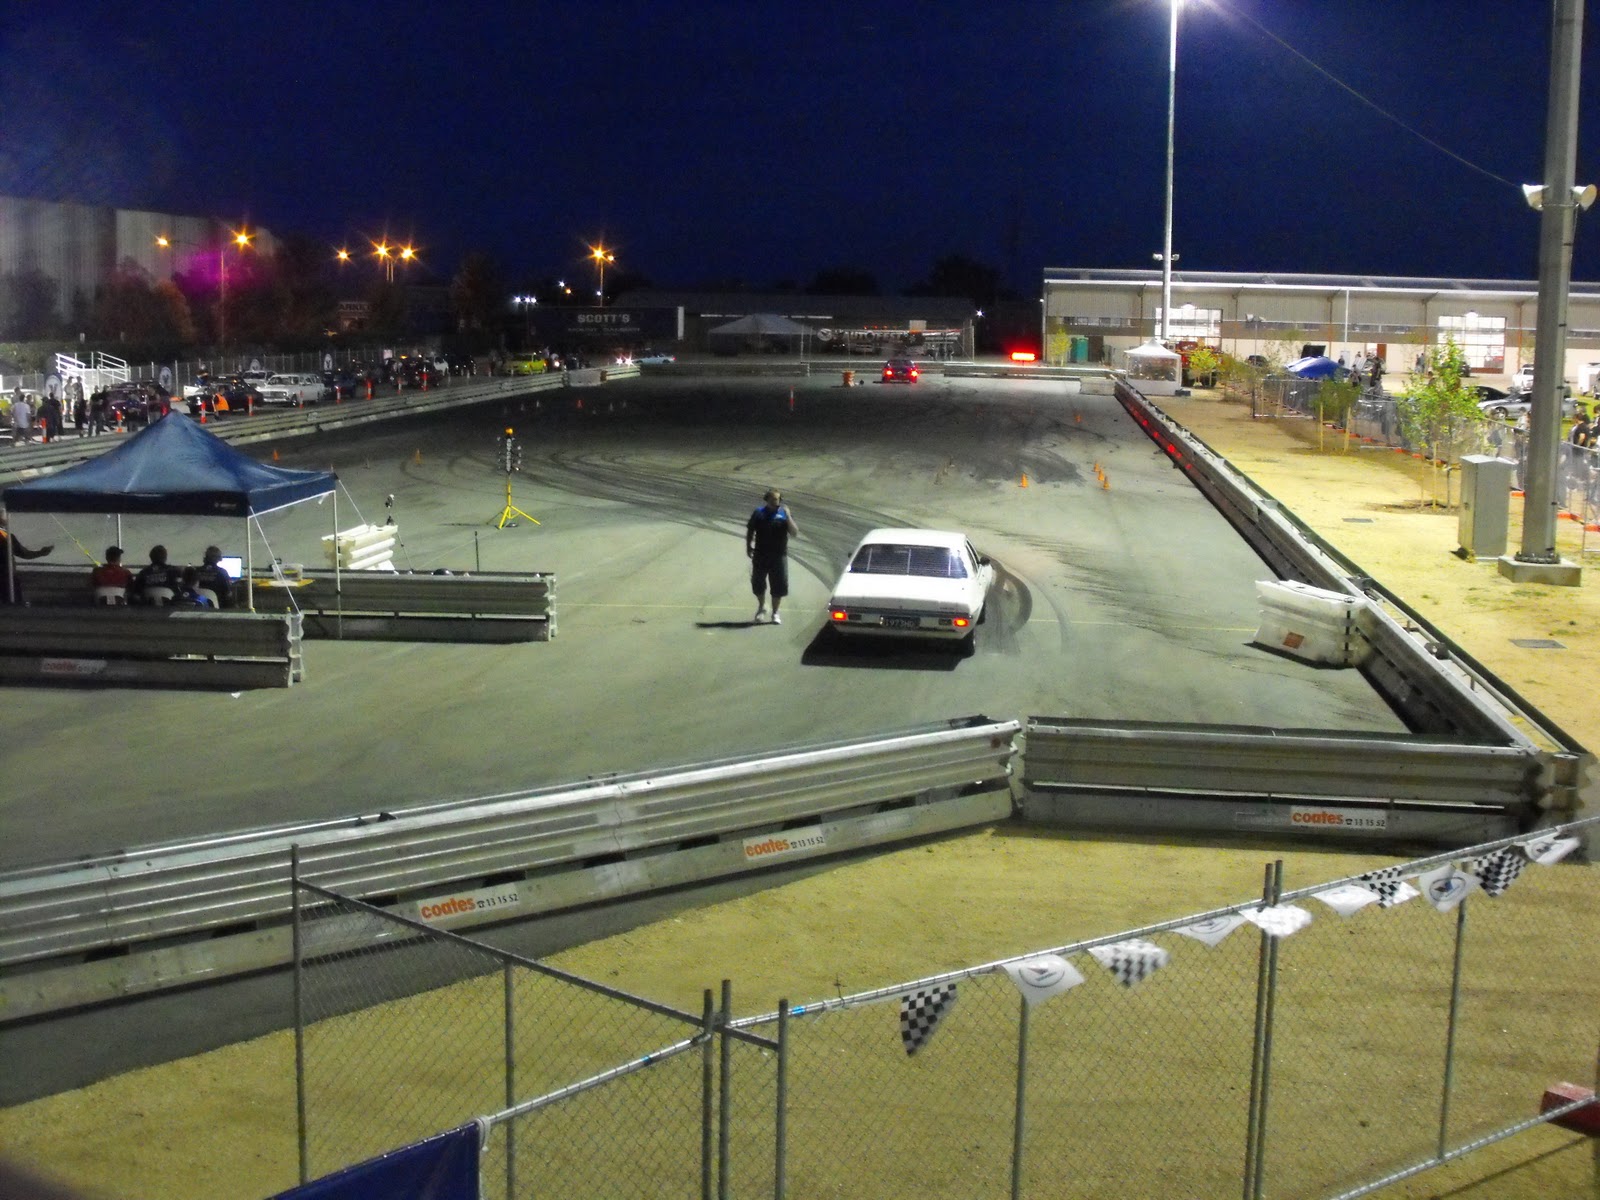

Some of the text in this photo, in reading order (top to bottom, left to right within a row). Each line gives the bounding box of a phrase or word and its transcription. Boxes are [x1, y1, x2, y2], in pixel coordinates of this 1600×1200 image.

[577, 314, 630, 323] SCOTT'S
[1292, 811, 1344, 825] coates
[1375, 819, 1385, 827] 52
[745, 836, 824, 857] coates 13 15 52
[421, 893, 519, 919] coates 13 15 52
